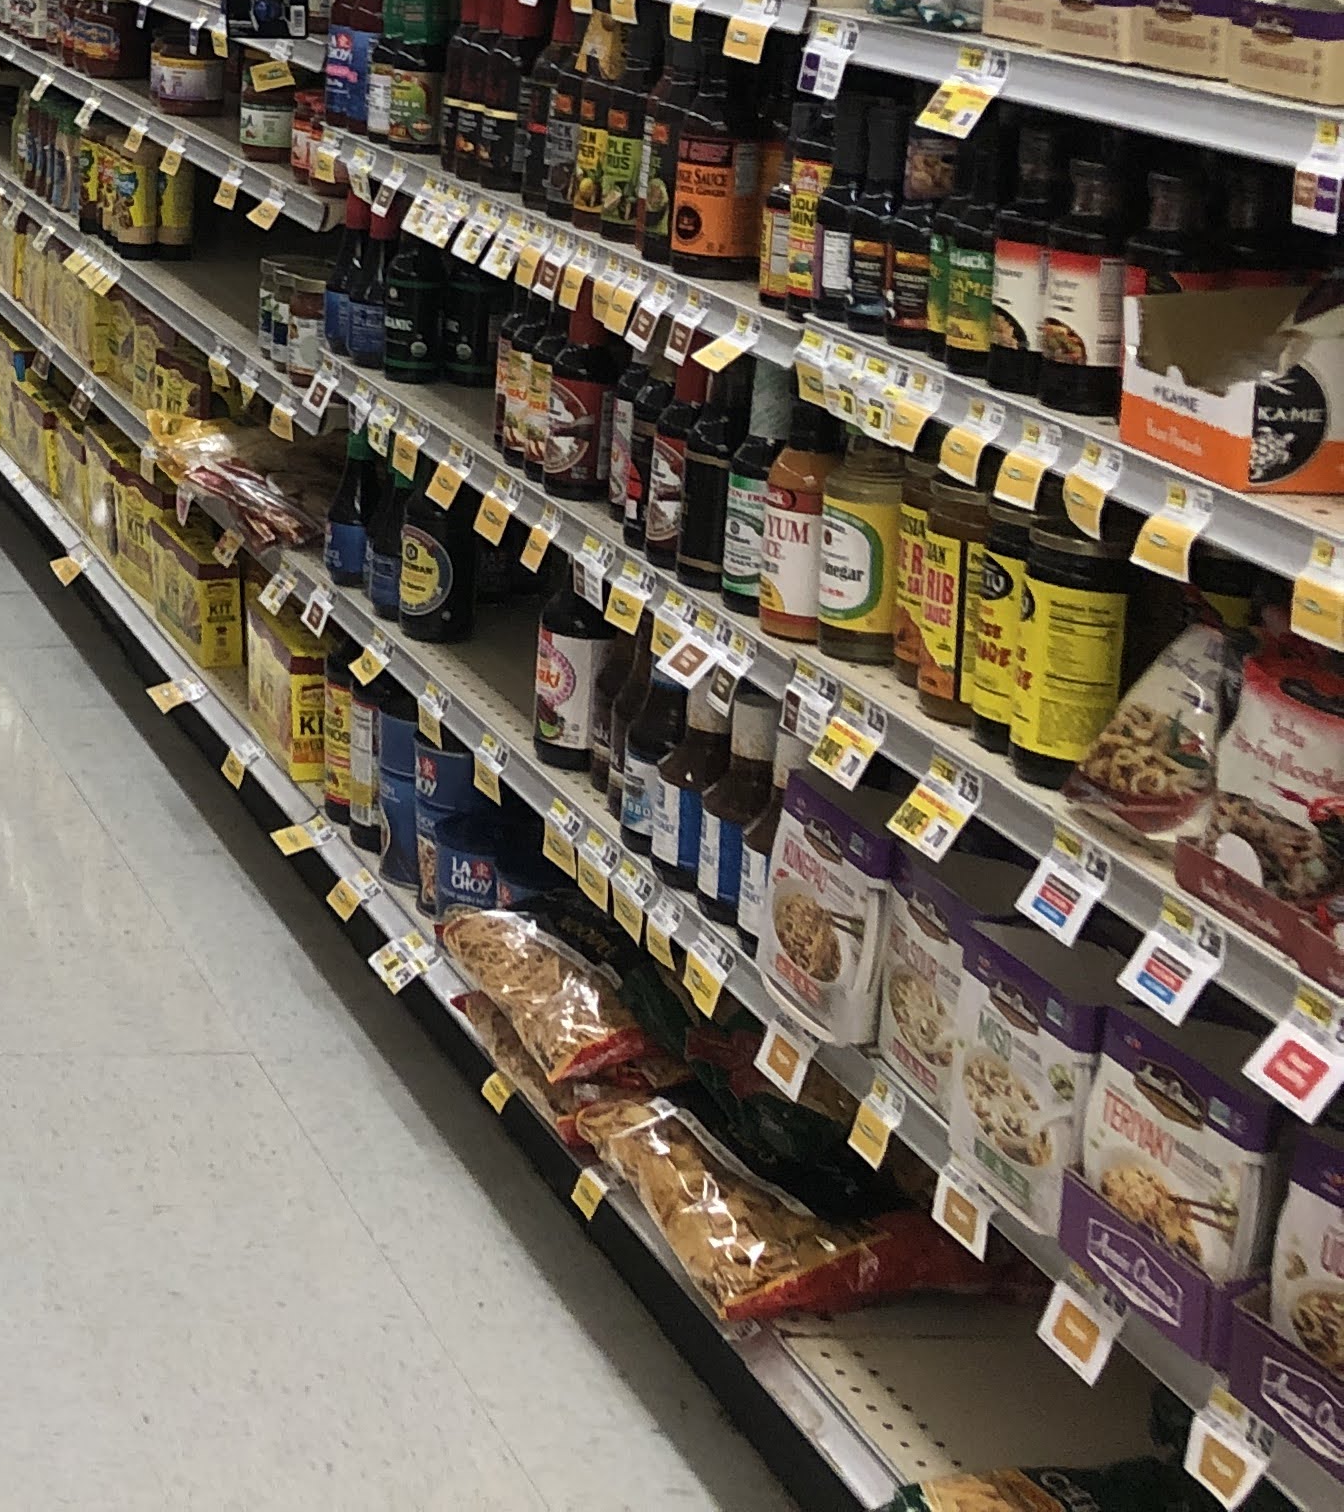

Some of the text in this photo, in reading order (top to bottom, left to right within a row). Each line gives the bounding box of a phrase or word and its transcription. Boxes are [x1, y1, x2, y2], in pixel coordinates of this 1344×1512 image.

[692, 171, 729, 185] SAUCE
[767, 519, 809, 543] YUM
[820, 565, 863, 587] inegar
[928, 573, 954, 605] RIB
[452, 856, 471, 874] LA
[452, 873, 493, 894] CHOY
